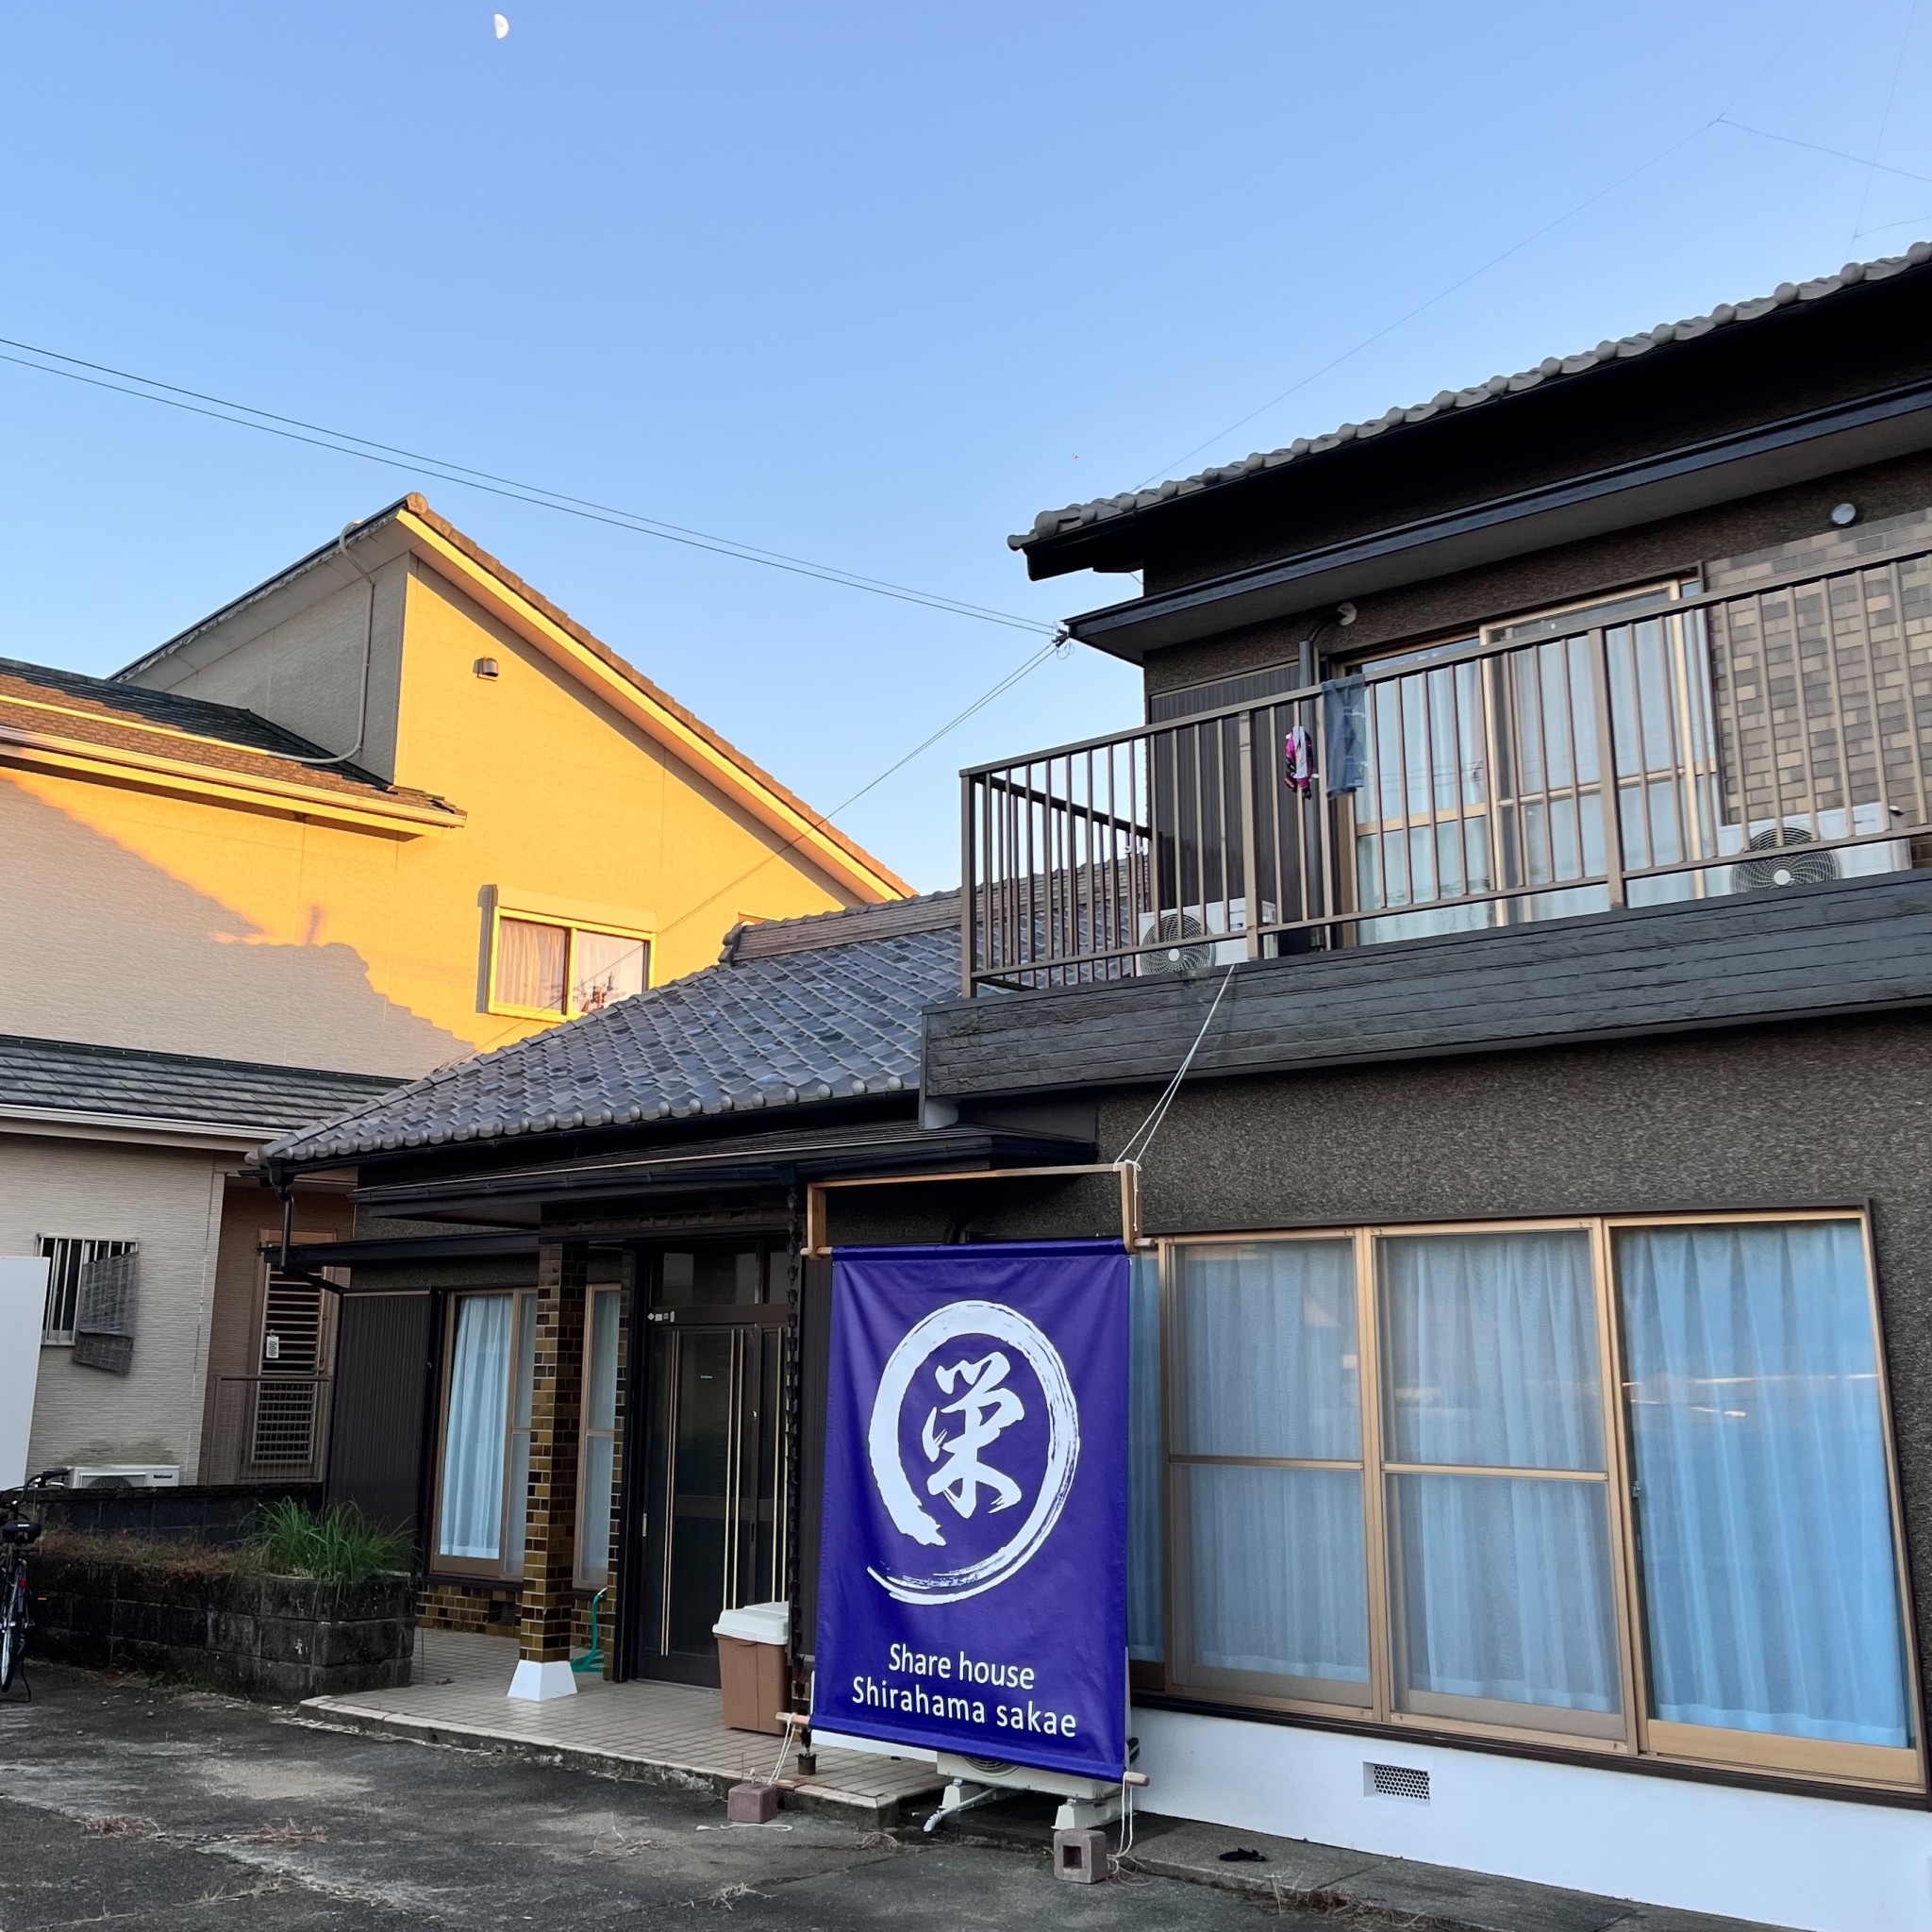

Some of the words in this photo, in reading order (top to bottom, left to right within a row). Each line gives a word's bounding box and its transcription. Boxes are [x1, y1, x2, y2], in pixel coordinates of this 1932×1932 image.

[921, 1352, 1024, 1519] 栄
[889, 1643, 951, 1679] Share
[959, 1651, 1035, 1690] house
[852, 1676, 985, 1724] Shirahama
[997, 1701, 1076, 1738] sakae
